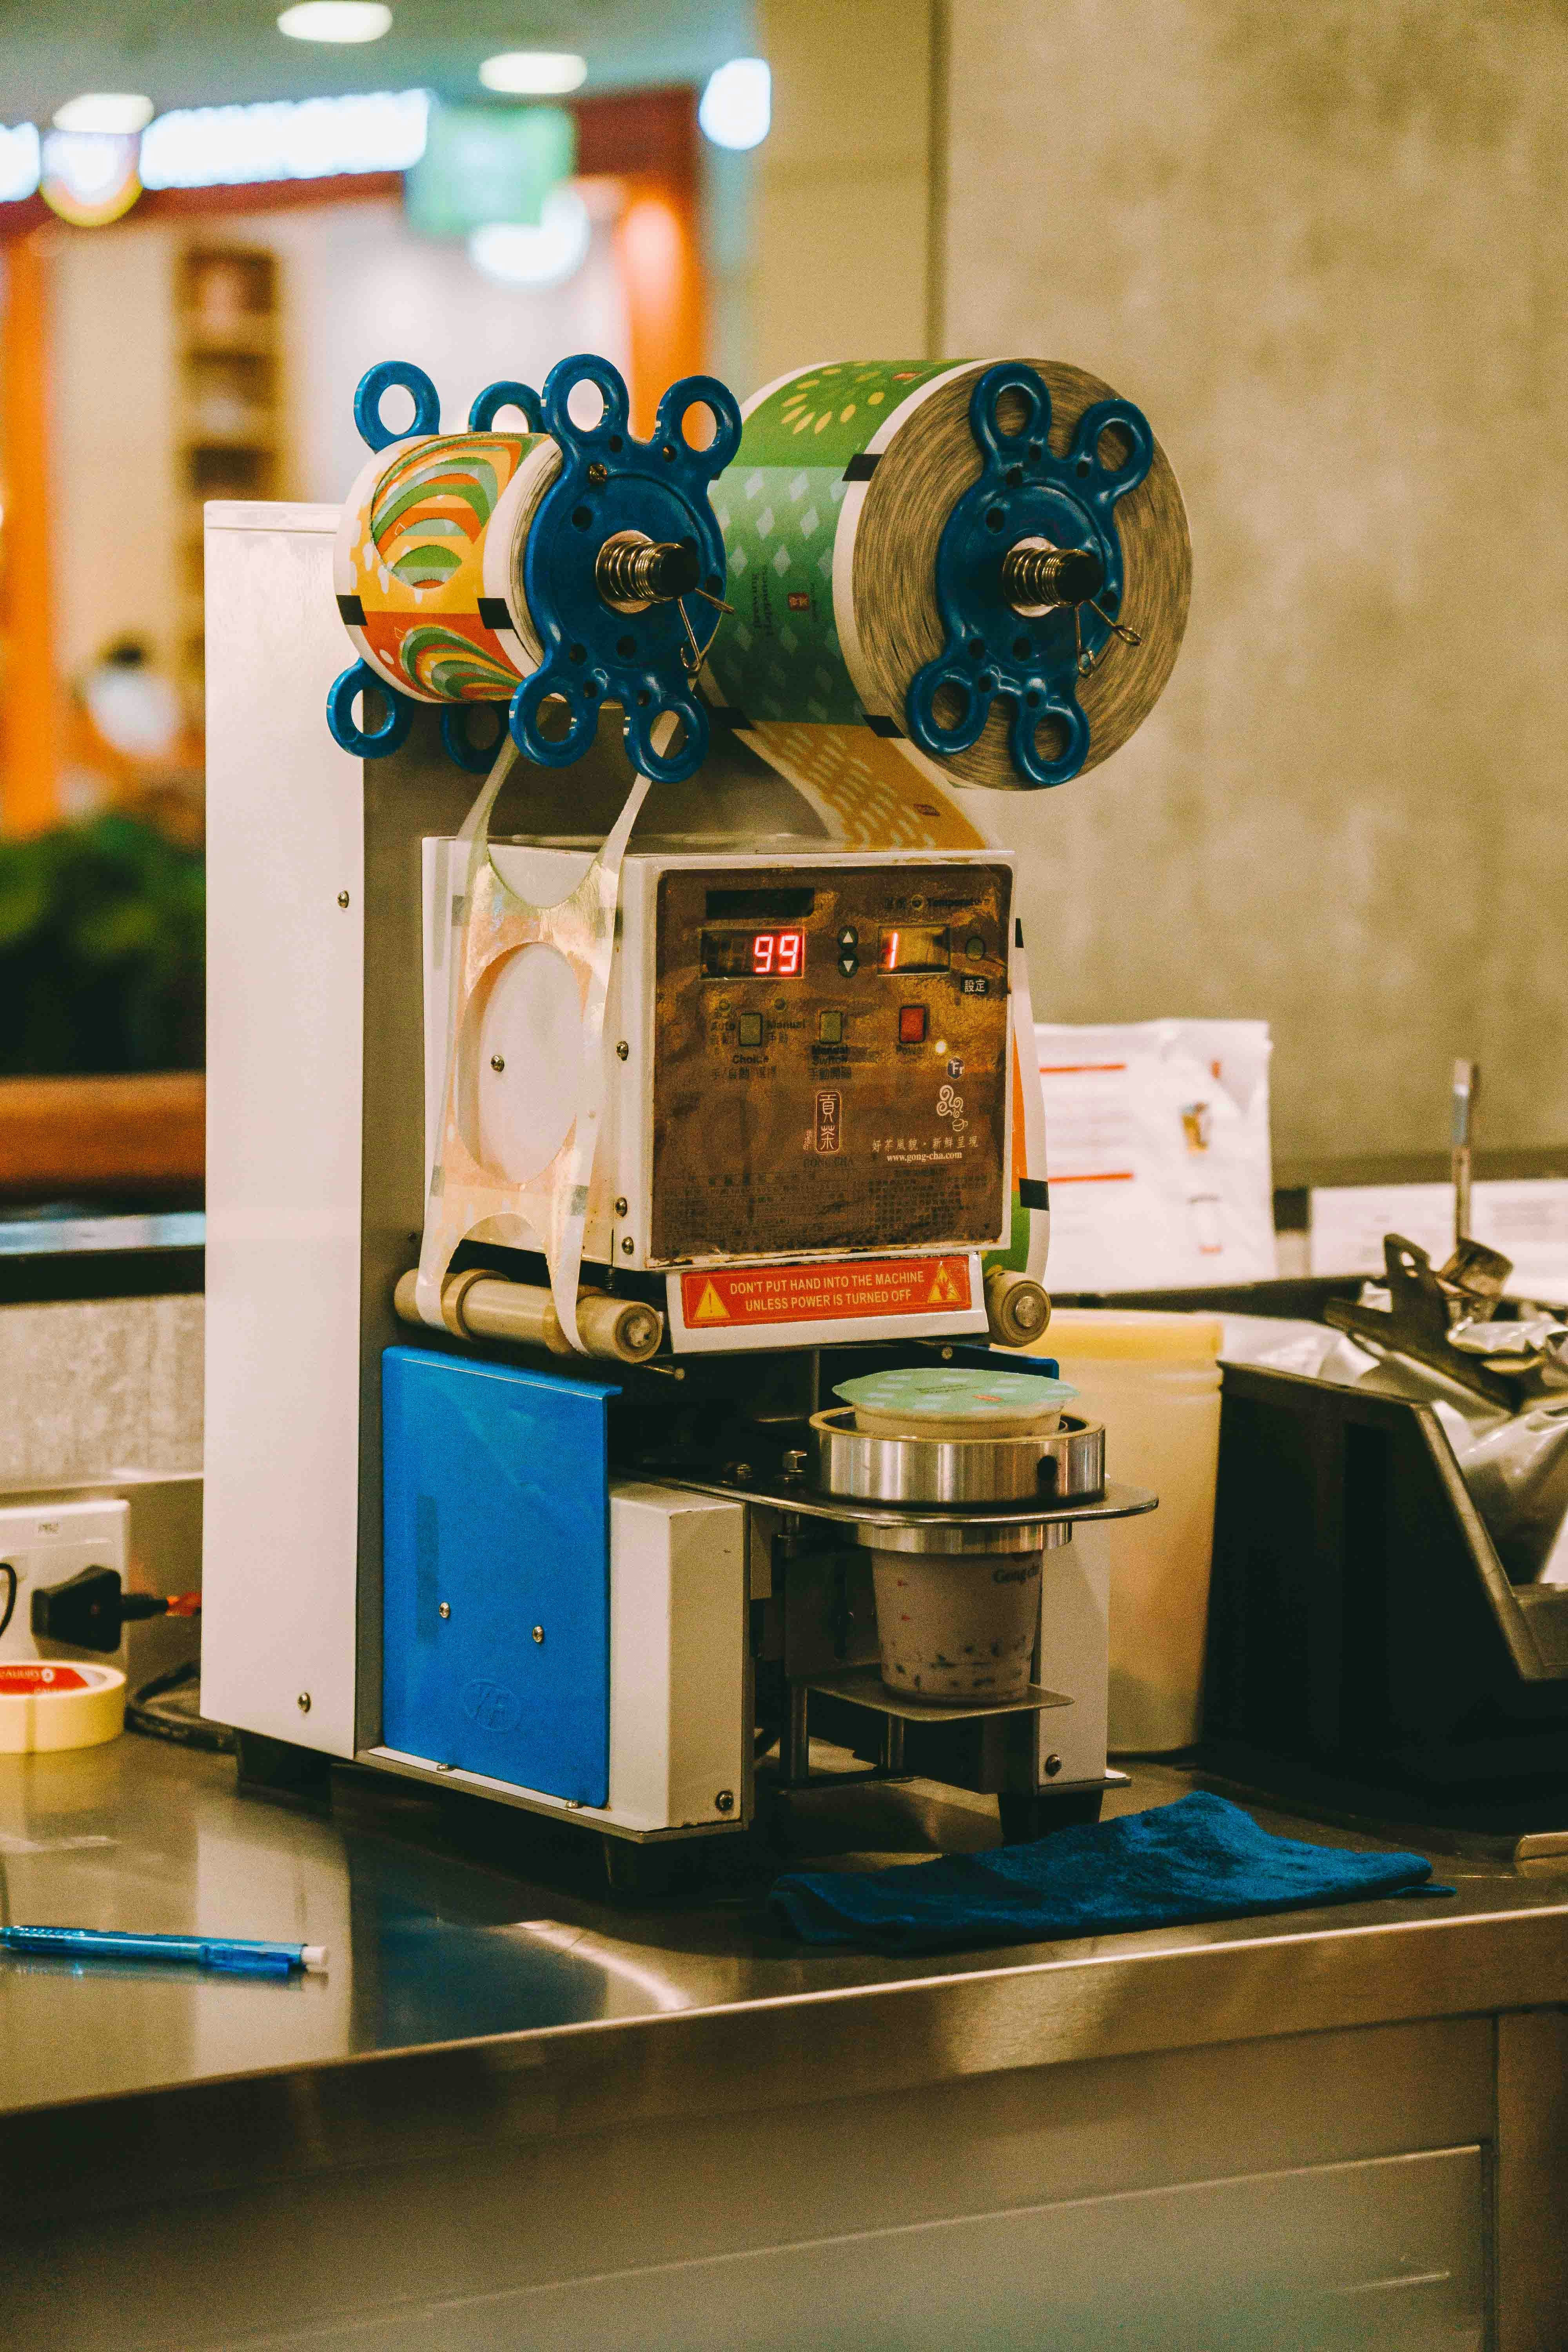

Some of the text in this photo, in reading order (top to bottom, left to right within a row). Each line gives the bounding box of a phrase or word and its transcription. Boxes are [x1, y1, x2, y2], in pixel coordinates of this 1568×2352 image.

[754, 935, 799, 973] 99
[889, 931, 899, 969] 1
[964, 979, 985, 993] 設定
[732, 1054, 769, 1064] Choice
[819, 1094, 838, 1150] 貢茶
[887, 1151, 963, 1163] www.gong-cha.com
[730, 1270, 925, 1294] DON'T PUT HAND INTO THE MACHINE
[746, 1289, 912, 1311] UNLESS POWER IS TURNED OFF
